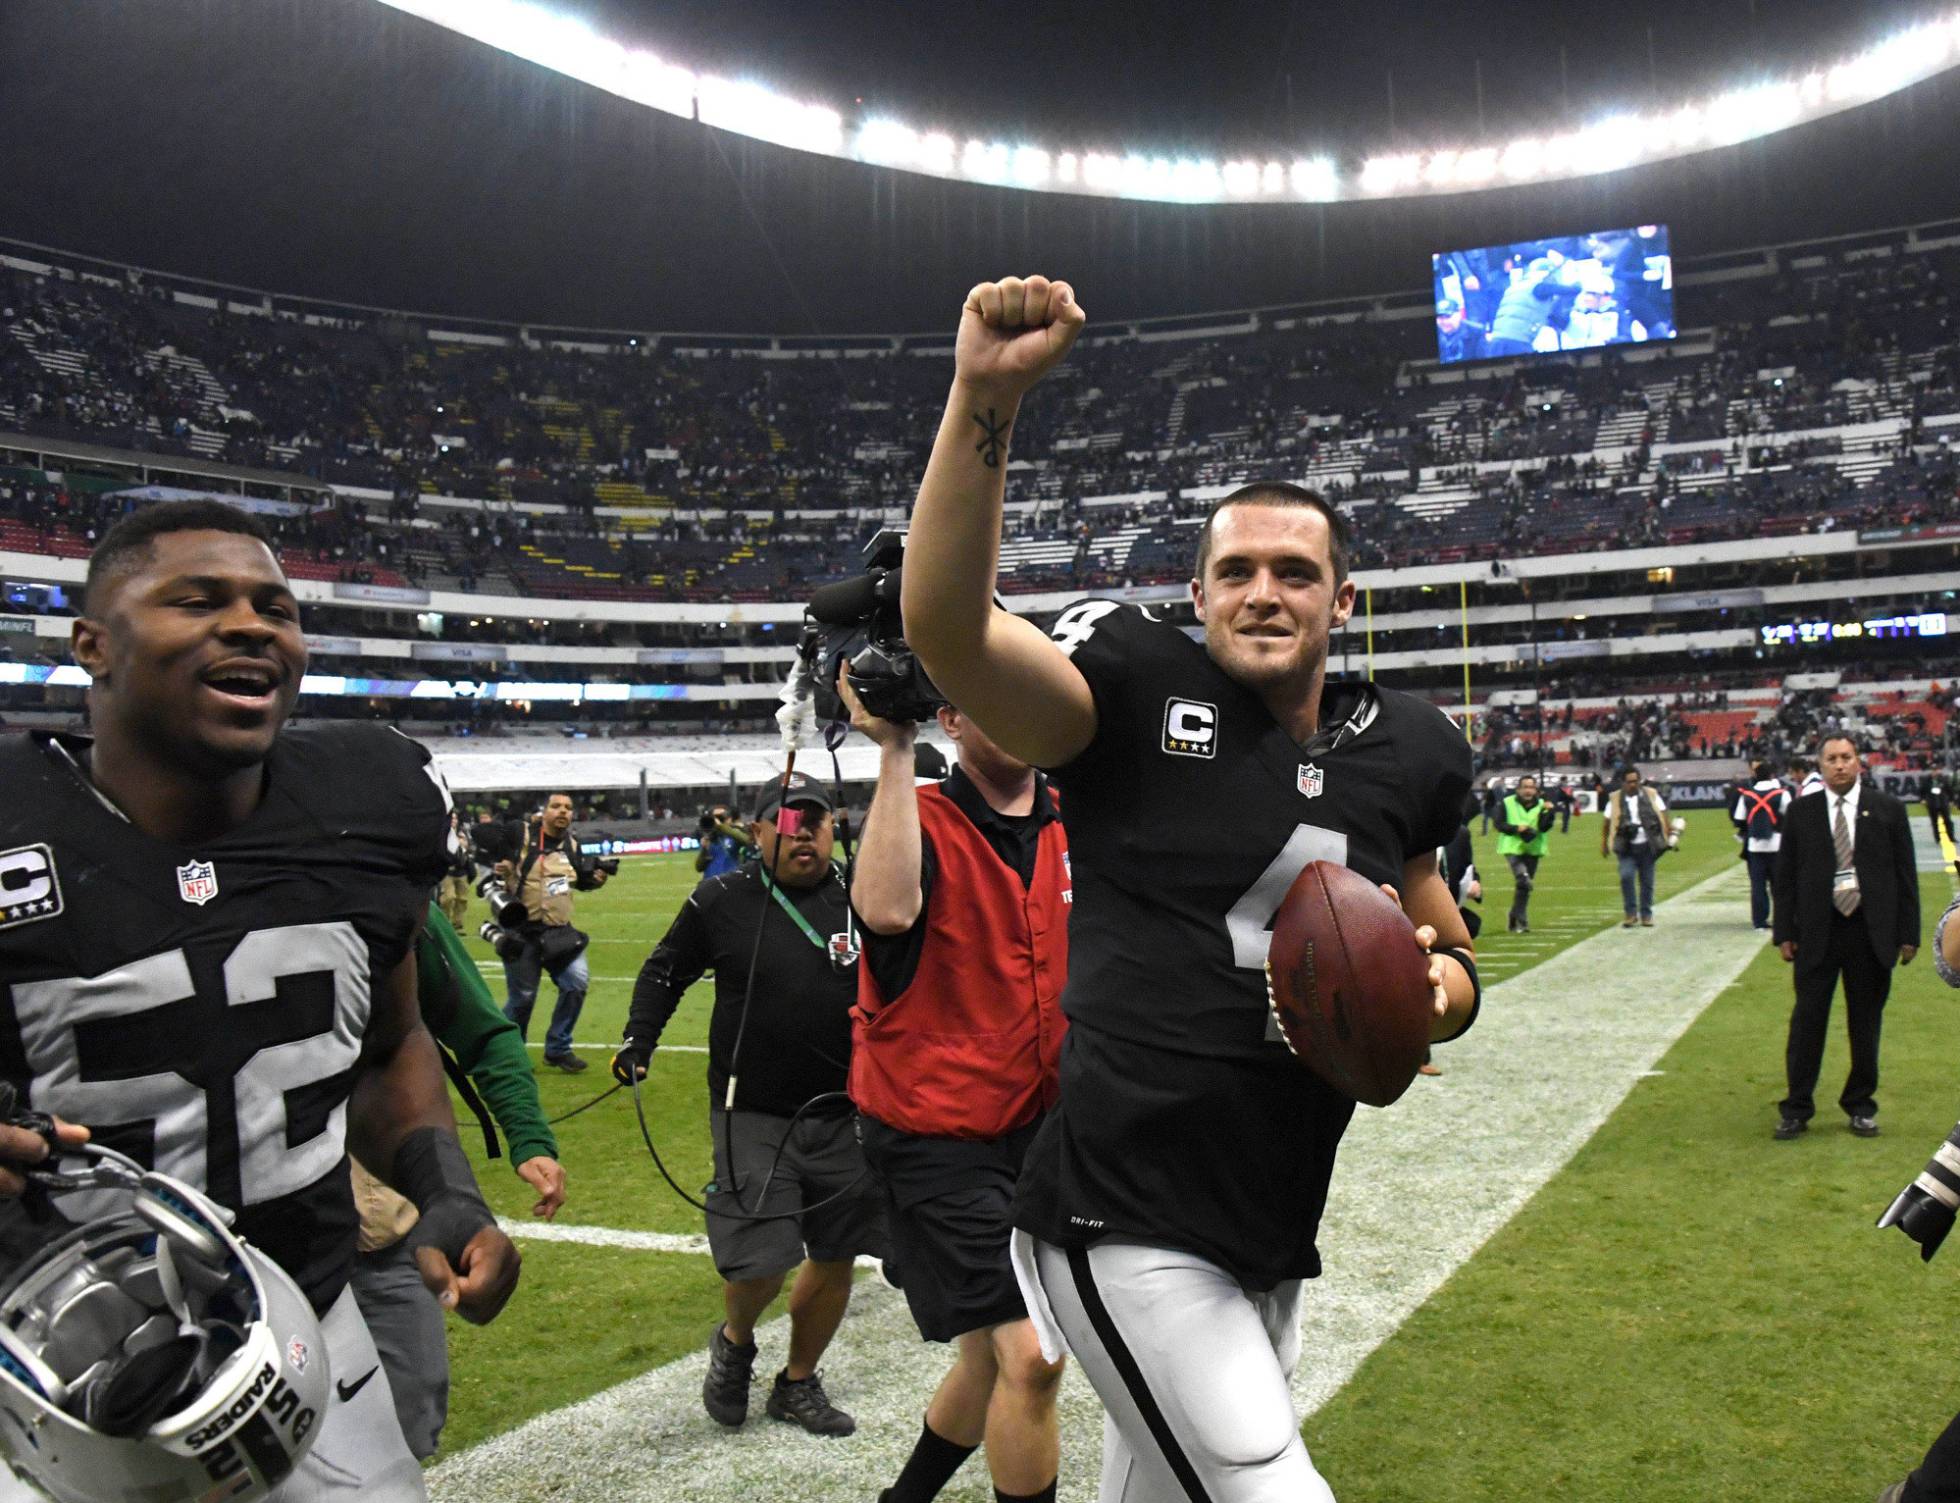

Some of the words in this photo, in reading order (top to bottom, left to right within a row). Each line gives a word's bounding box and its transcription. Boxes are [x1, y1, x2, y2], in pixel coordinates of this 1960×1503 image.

[1168, 702, 1214, 743] C
[1671, 785, 1727, 800] KLAN
[0, 851, 51, 908] C
[184, 879, 213, 898] NFL
[11, 921, 371, 1223] 52
[1070, 1215, 1105, 1229] DRI-FIT
[185, 1361, 276, 1451] RAIDERS
